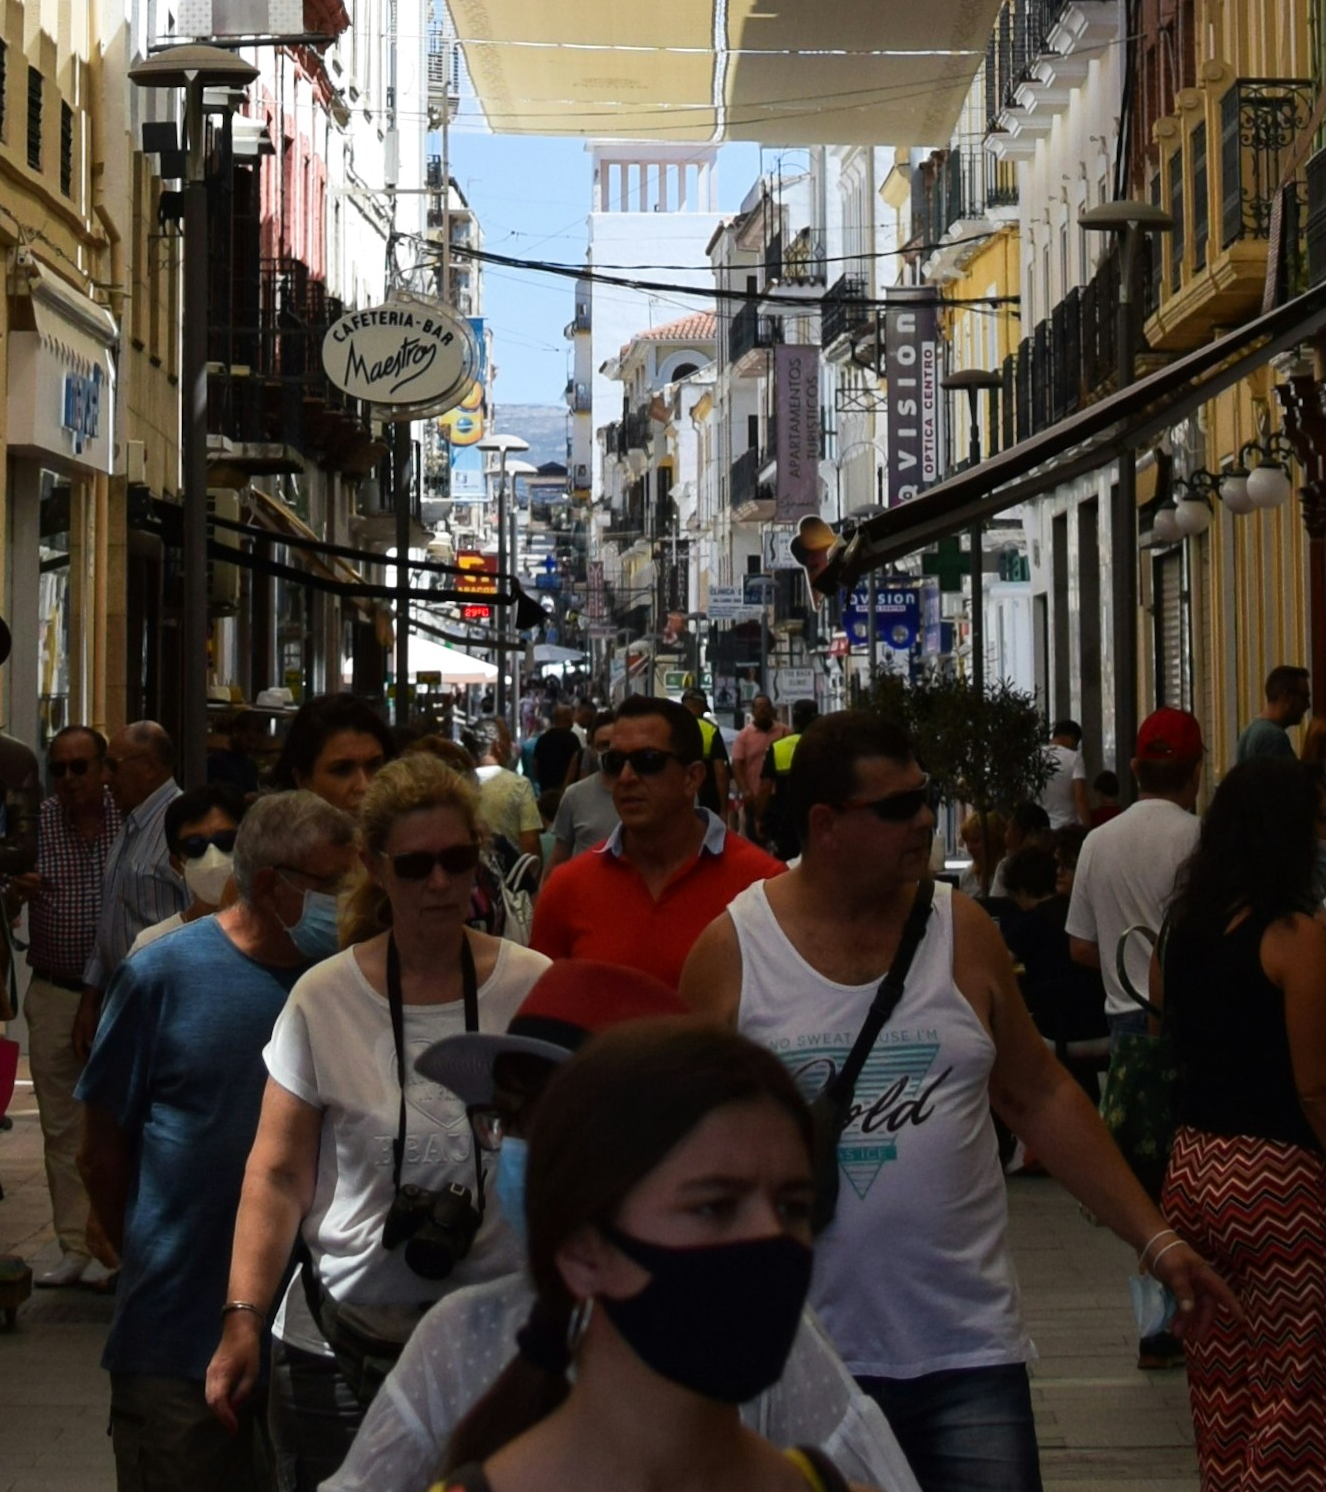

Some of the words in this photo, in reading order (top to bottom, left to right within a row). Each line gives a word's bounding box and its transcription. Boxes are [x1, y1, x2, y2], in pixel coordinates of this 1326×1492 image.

[332, 310, 454, 347] CAFETERIA-BAR
[924, 348, 934, 410] CENTRO
[787, 357, 802, 479] APARTAMENTOS
[924, 418, 934, 474] OPTICA
[770, 1038, 791, 1050] NO
[797, 1032, 851, 1046] SWEAT
[916, 1029, 938, 1040] I'M
[860, 1146, 886, 1159] ICE
